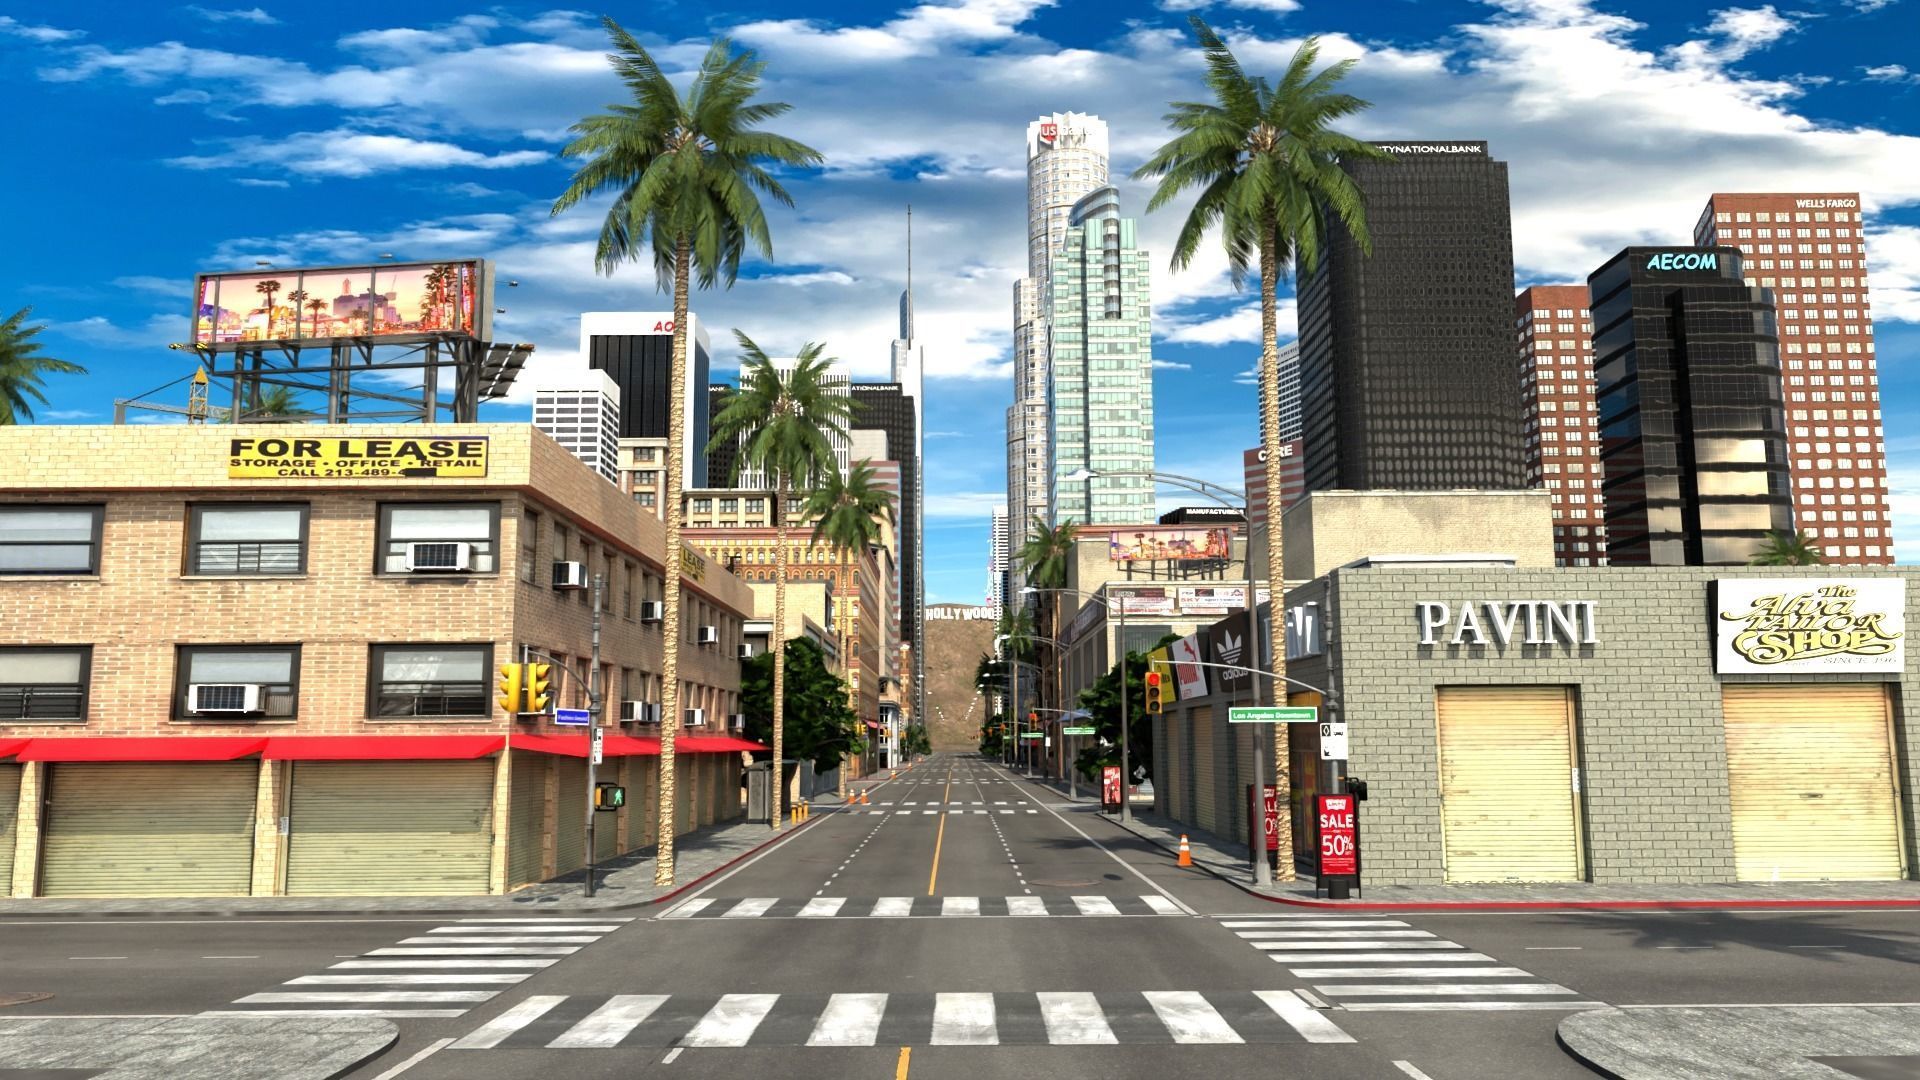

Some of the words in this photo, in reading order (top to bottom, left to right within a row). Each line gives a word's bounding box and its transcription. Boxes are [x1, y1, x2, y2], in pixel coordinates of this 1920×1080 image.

[1377, 145, 1482, 153] TYNATIONALBANK
[1796, 199, 1825, 208] WELLS
[1827, 199, 1857, 208] FARGO
[1646, 253, 1717, 271] AECOM
[653, 321, 675, 332] AO
[230, 439, 323, 458] FOR
[338, 440, 483, 458] LEASE
[230, 459, 316, 467] STORAGE
[336, 459, 400, 468] OFFICE
[420, 459, 482, 467] RETAIL
[278, 469, 319, 477] CALL
[325, 468, 409, 477] 213-489-4
[1818, 584, 1858, 598] The
[1720, 592, 1856, 621] Alva
[1416, 600, 1600, 645] PAVINI
[1743, 612, 1903, 639] TAILOR
[1732, 630, 1897, 665] SHOP
[1222, 666, 1249, 680] adidas
[1320, 814, 1354, 828] SALE
[1322, 835, 1354, 856] 50%
